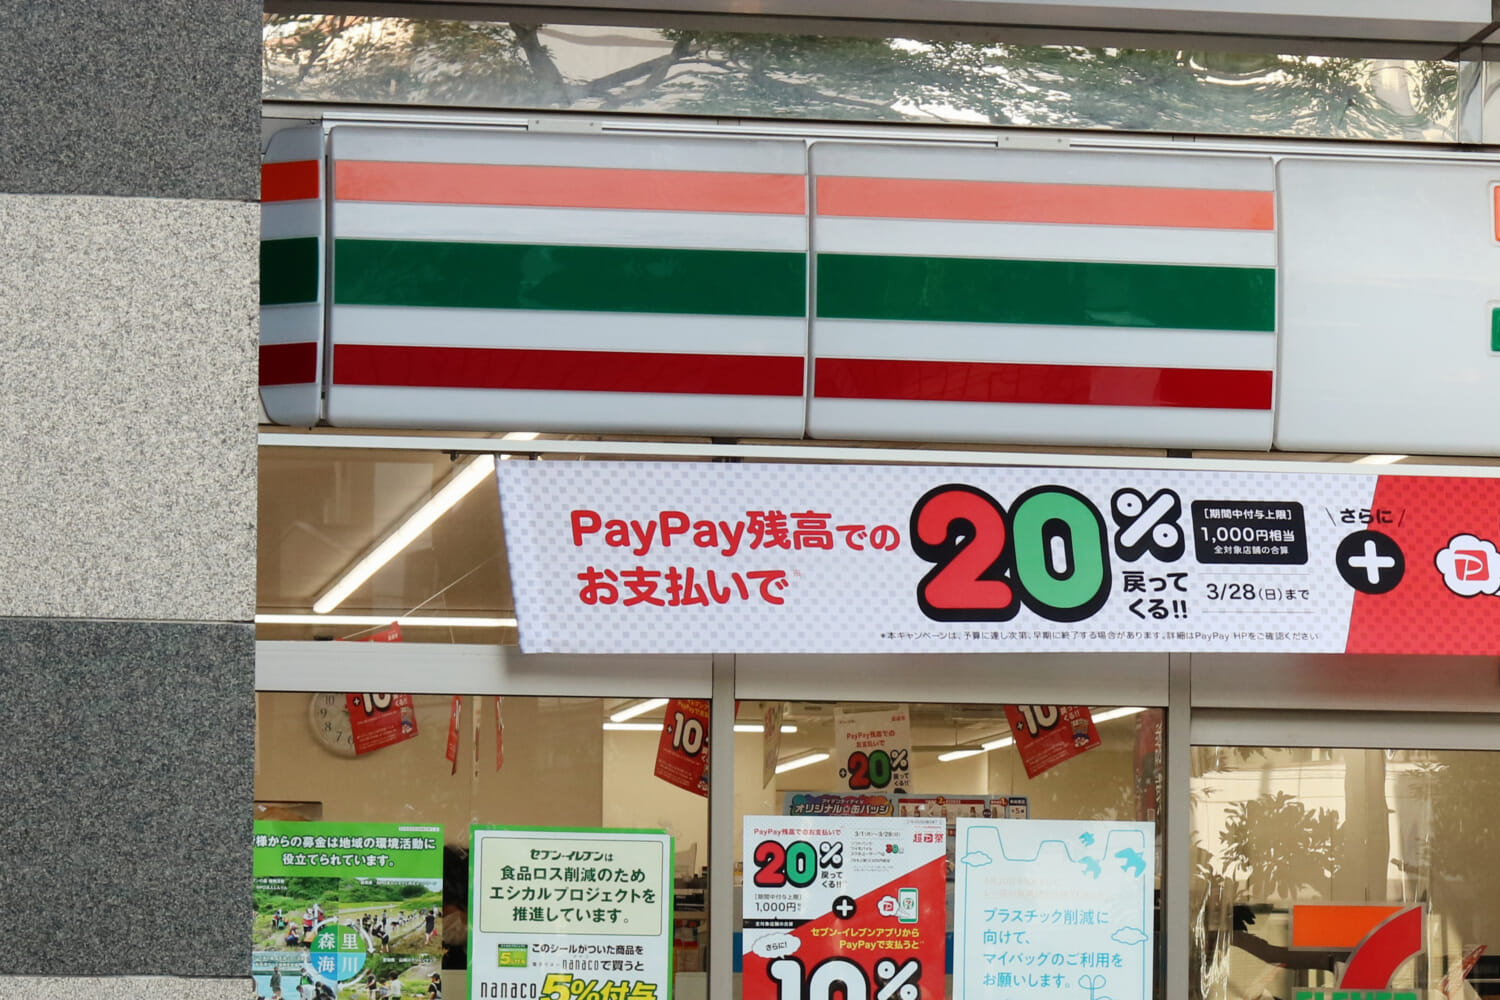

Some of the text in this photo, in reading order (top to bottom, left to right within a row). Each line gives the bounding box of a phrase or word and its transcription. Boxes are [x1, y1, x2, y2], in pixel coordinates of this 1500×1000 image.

[1339, 507, 1394, 524] さらに
[569, 508, 901, 557] PayPay残高での
[1200, 527, 1296, 543] 1,000円相当
[909, 482, 1186, 623] 20%
[1213, 545, 1289, 555] 全対象店舗の合算
[577, 565, 791, 607] お支払いで
[1122, 570, 1190, 594] 戻って
[1127, 597, 1189, 620] くる!!
[847, 749, 909, 791] 20%
[753, 828, 841, 837] PayPay残高でのお支払いで
[252, 834, 436, 850] 様からの募金は地域の環境活動に
[282, 853, 395, 867] 役立てられています。
[753, 840, 844, 888] 20%
[500, 865, 646, 884] 食品ロス削減のため
[820, 870, 843, 880] 戻って
[489, 885, 656, 904] エシカルプロジェクトを
[512, 906, 629, 924] 推進しています。
[983, 908, 1110, 925] プラスチック削減に
[317, 932, 359, 951] 森 里
[839, 940, 920, 951] PayPayで支払うと
[983, 930, 1032, 945] 向けて、
[531, 943, 644, 956] このシールがついた商品を
[318, 956, 336, 973] 海
[342, 957, 358, 973] 川
[562, 959, 645, 972] nanacoで買うと
[983, 951, 1124, 968] マイバッグのご利用を
[982, 972, 1072, 989] お願いします。
[480, 982, 537, 999] nanaco
